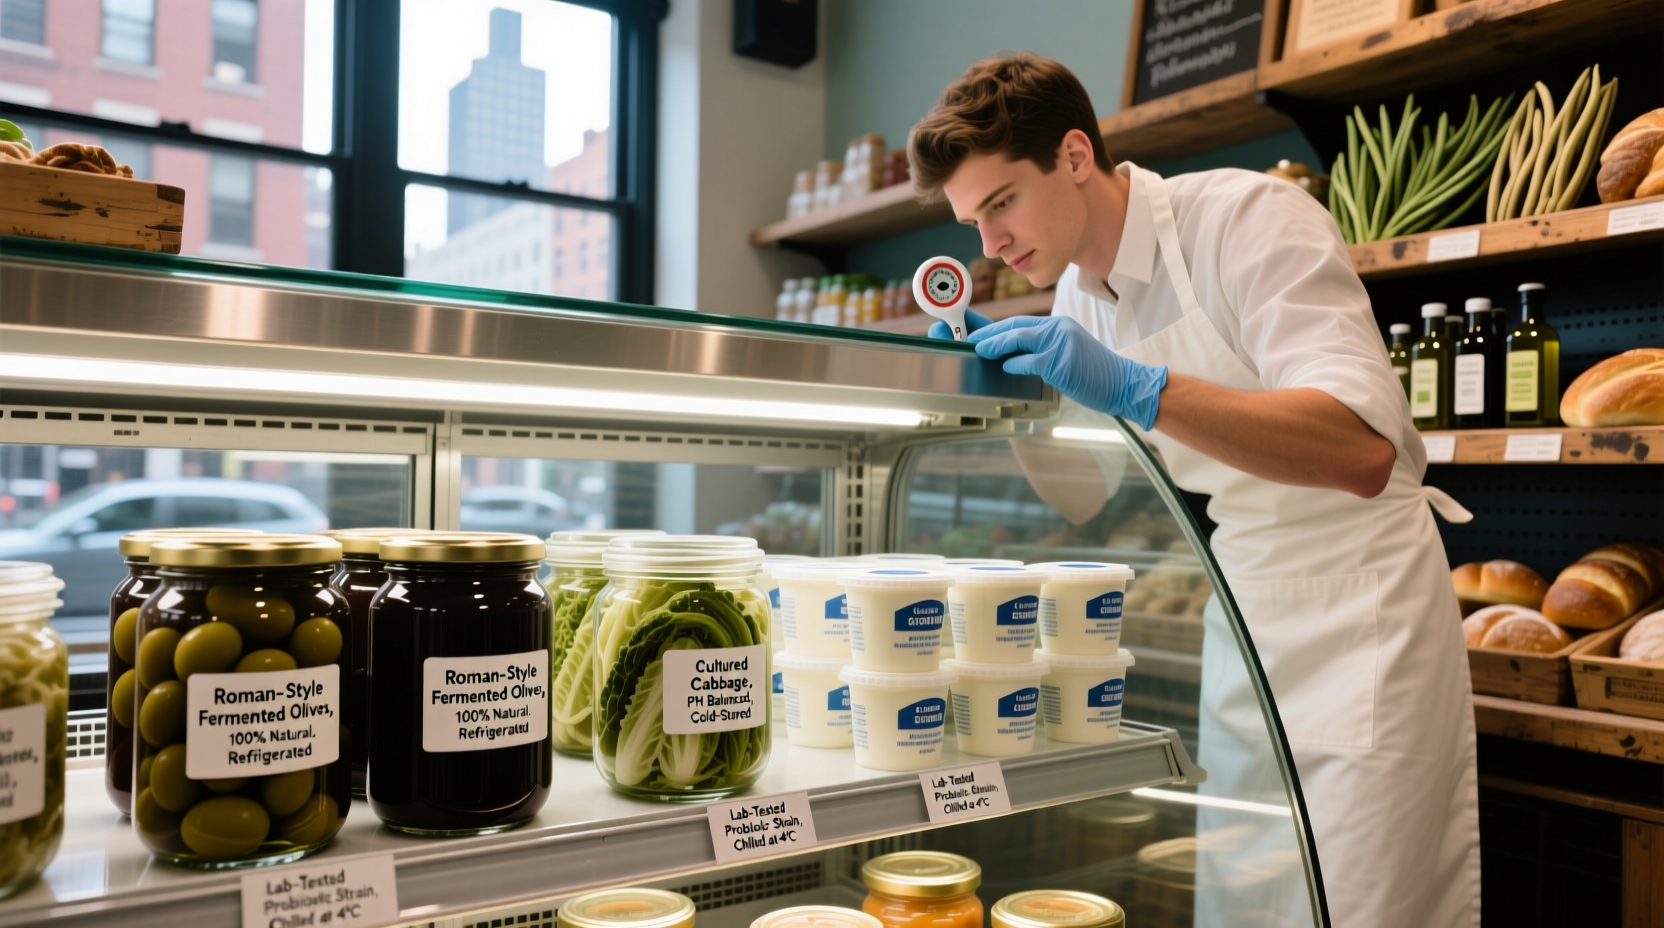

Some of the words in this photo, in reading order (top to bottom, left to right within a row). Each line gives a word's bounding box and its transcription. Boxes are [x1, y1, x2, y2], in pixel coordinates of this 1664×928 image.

[445, 663, 537, 685] Roman-Style
[695, 655, 748, 673] Cultured
[214, 679, 324, 705] Roman-Style
[690, 676, 753, 692] Cabbage,
[431, 685, 508, 705] Fermented
[687, 695, 704, 708] PH
[198, 705, 286, 726] Fermented
[455, 708, 490, 723] 100%
[228, 731, 267, 746] 100%
[729, 801, 786, 821] Lab-Tested
[266, 869, 346, 895] Lab-Tested
